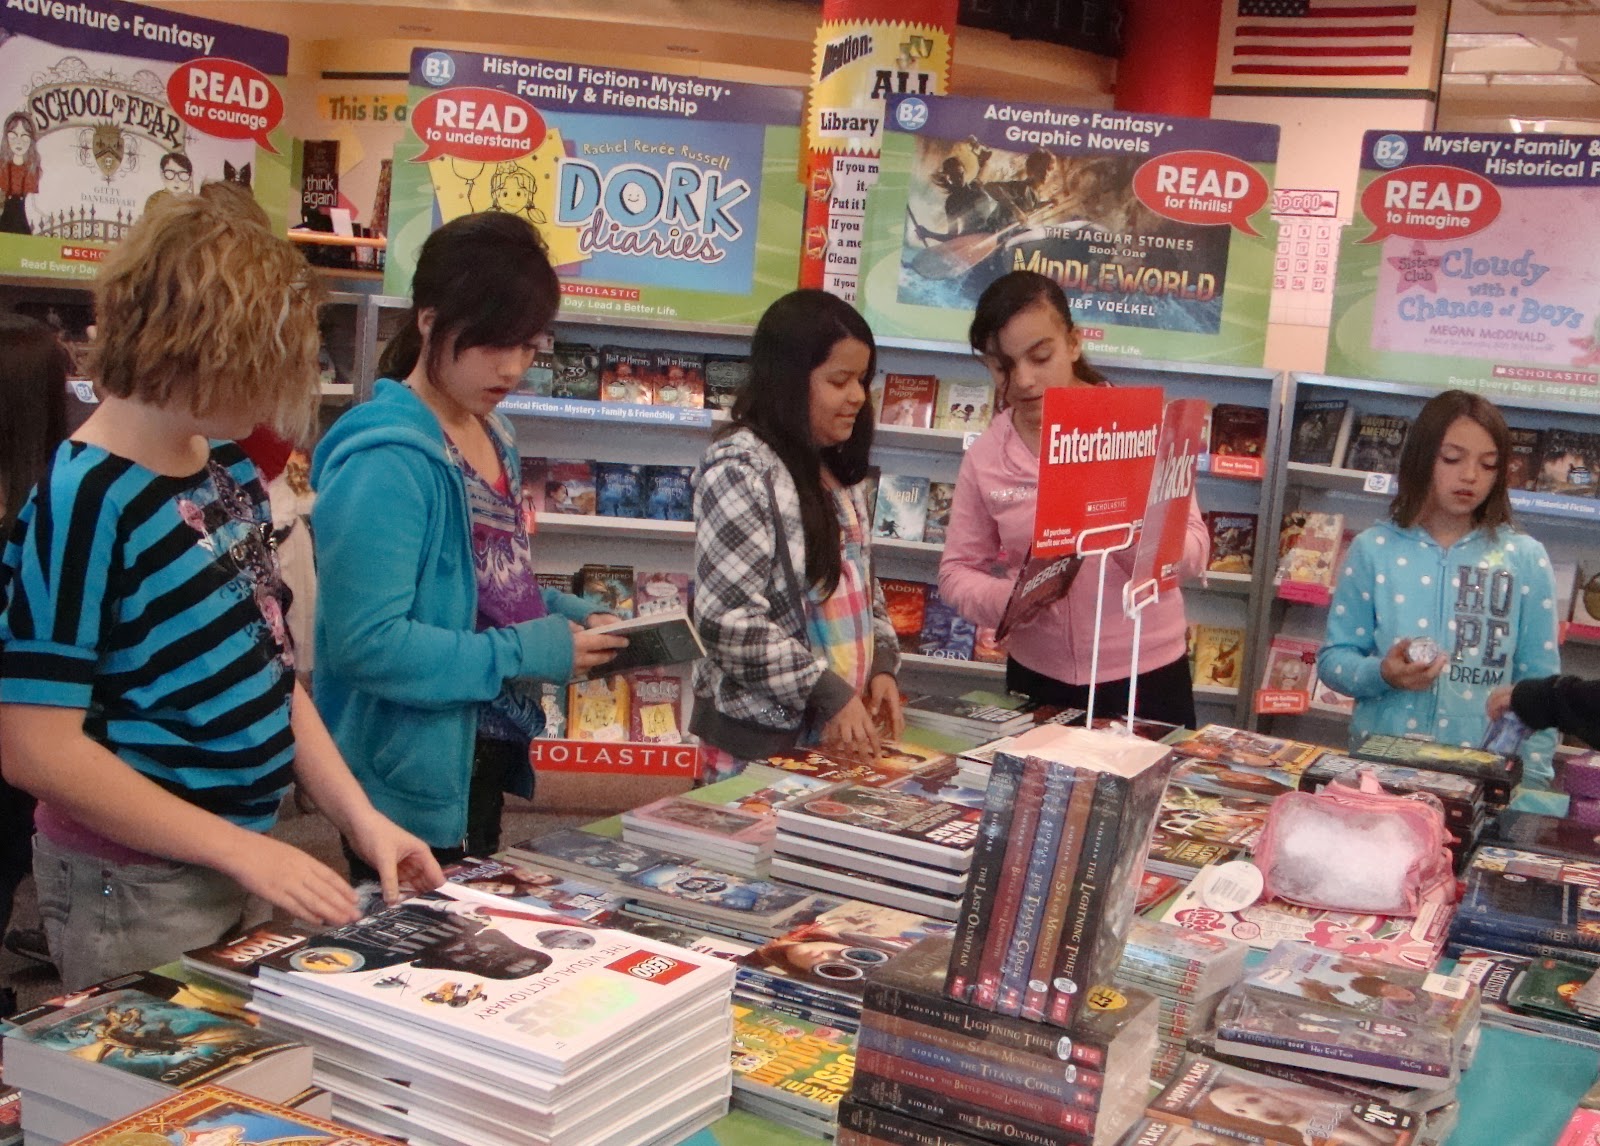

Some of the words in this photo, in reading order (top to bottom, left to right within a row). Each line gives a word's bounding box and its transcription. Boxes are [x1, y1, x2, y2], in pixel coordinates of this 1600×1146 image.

[7, 0, 121, 32] Adventure
[133, 15, 215, 56] Fantasy
[425, 58, 452, 78] B1
[483, 56, 573, 83] Historical
[577, 67, 640, 90] Fiction
[650, 74, 723, 101] Mystery
[187, 67, 270, 111] READ
[516, 80, 579, 104] Family
[582, 86, 597, 103] &
[602, 88, 699, 117] Friendship
[31, 87, 115, 131] SCHOOL
[112, 93, 127, 113] OF
[123, 94, 182, 149] FEAR
[184, 100, 206, 119] for
[207, 107, 269, 130] courage
[328, 95, 367, 121] This
[372, 97, 389, 122] is
[394, 104, 408, 122] a
[434, 98, 529, 135] READ
[899, 103, 927, 124] B2
[983, 103, 1081, 128] Adventure
[1091, 113, 1166, 137] Fantasy
[820, 111, 880, 138] Library
[425, 126, 442, 142] to
[444, 130, 532, 150] understand
[1004, 125, 1082, 149] Graphic
[1087, 133, 1151, 153] Novels
[1376, 140, 1406, 160] B2
[1423, 135, 1502, 155] Mystery
[1513, 138, 1583, 159] Family
[1587, 140, 1600, 157] &
[582, 141, 630, 157] Rachel
[633, 139, 677, 157] Renée
[680, 144, 732, 171] Russell
[835, 159, 845, 172] If
[845, 162, 866, 176] you
[1485, 157, 1585, 178] Historical
[306, 173, 335, 191] think
[1155, 164, 1250, 200] READ
[302, 188, 338, 209] again!
[557, 161, 749, 240] DORK
[831, 197, 850, 211] Put
[851, 198, 861, 211] it
[1164, 195, 1184, 211] for
[1187, 197, 1234, 214] thrills!
[1383, 179, 1483, 213] READ
[830, 218, 840, 231] If
[840, 221, 860, 233] you
[1385, 210, 1403, 225] to
[1404, 212, 1471, 231] imagine
[579, 209, 726, 262] diaries
[1044, 227, 1071, 240] THE
[1075, 229, 1133, 245] JAGUAR
[1137, 235, 1195, 251] STONES
[827, 252, 858, 266] Clean
[1087, 244, 1119, 256] Book
[1122, 248, 1148, 259] One
[1398, 254, 1441, 271] Sisters
[20, 257, 47, 270] Read
[49, 261, 80, 275] Every
[79, 264, 99, 276] Day
[1012, 248, 1216, 303] MIDDLEWORLD
[1404, 268, 1433, 283] Club
[1440, 247, 1551, 287] Cloudy
[560, 283, 639, 299] SCHOLASTIC
[833, 277, 841, 287] If
[840, 279, 856, 289] you
[1467, 281, 1506, 297] with
[564, 297, 586, 307] Day.
[588, 299, 613, 311] Lead
[624, 301, 656, 315] Better
[656, 306, 679, 317] Life.
[1096, 300, 1156, 317] VOELKEL
[1397, 293, 1495, 323] Chance
[1499, 303, 1517, 317] of
[1517, 296, 1586, 330] Boys
[1429, 325, 1475, 338] MEGAN
[1479, 327, 1547, 343] McDONALD
[1086, 342, 1120, 354] Better
[1120, 344, 1143, 356] Life.
[1448, 375, 1477, 388] Read
[1478, 378, 1509, 392] Every
[1512, 381, 1537, 393] Day.
[1538, 384, 1568, 396] Lead
[1507, 367, 1597, 384] SCHOLASTIC
[531, 402, 559, 413] Fiction
[564, 404, 596, 417] Mystery
[601, 407, 627, 420] Family
[634, 408, 676, 422] Friendship
[1048, 422, 1158, 465] Entertainment
[880, 581, 924, 595] HADDIX
[1020, 557, 1071, 599] BIEBER
[922, 647, 971, 663] TORN
[1449, 664, 1505, 685] DREAM
[531, 744, 692, 769] HOLASTIC
[984, 811, 1001, 853] RIORDAN
[1091, 820, 1106, 861] RIORDAN
[976, 866, 989, 885] THE
[1085, 860, 1098, 882] THE
[972, 883, 988, 914] LAST
[1053, 881, 1068, 906] SEA
[1070, 881, 1097, 944] LIGHTNING
[225, 932, 309, 964] THOR
[605, 942, 633, 959] THE
[960, 913, 982, 968] OLYMPIAN
[1038, 915, 1061, 970] MONSTERS
[551, 954, 602, 979] VISUAL
[628, 954, 679, 980] LEGO
[1012, 939, 1031, 980] CURSE
[1062, 943, 1081, 979] THIEF
[474, 975, 561, 1021] DICTIONARY
[905, 1003, 941, 1018] RIORDAN
[942, 1011, 961, 1025] THE
[963, 1013, 1022, 1041] LIGHTNING
[1023, 1032, 1056, 1051] THIEF
[999, 1050, 1054, 1075] MONSTERS
[1309, 1043, 1323, 1055] Her
[1323, 1046, 1338, 1058] Evil
[1337, 1048, 1354, 1060] Twin
[159, 1052, 214, 1083] HERO
[900, 1068, 937, 1083] RIORDAN
[911, 1047, 952, 1063] RIORDAN
[959, 1060, 978, 1072] THE
[979, 1062, 1024, 1085] TITAN'S
[1023, 1076, 1064, 1097] CURSE
[779, 1078, 845, 1106] Bikini
[1169, 1080, 1194, 1105] PUPPY
[1185, 1061, 1211, 1088] PLACE
[879, 1122, 915, 1139] RIORDAN
[915, 1132, 934, 1146] THE
[907, 1098, 945, 1115] RIORDAN
[957, 1111, 975, 1124] THE
[975, 1114, 1002, 1133] LAST
[1003, 1123, 1058, 1146] OLYMPIAN
[1137, 1122, 1168, 1146] PLACE
[1195, 1122, 1212, 1133] THE
[1211, 1125, 1236, 1138] PUPPY
